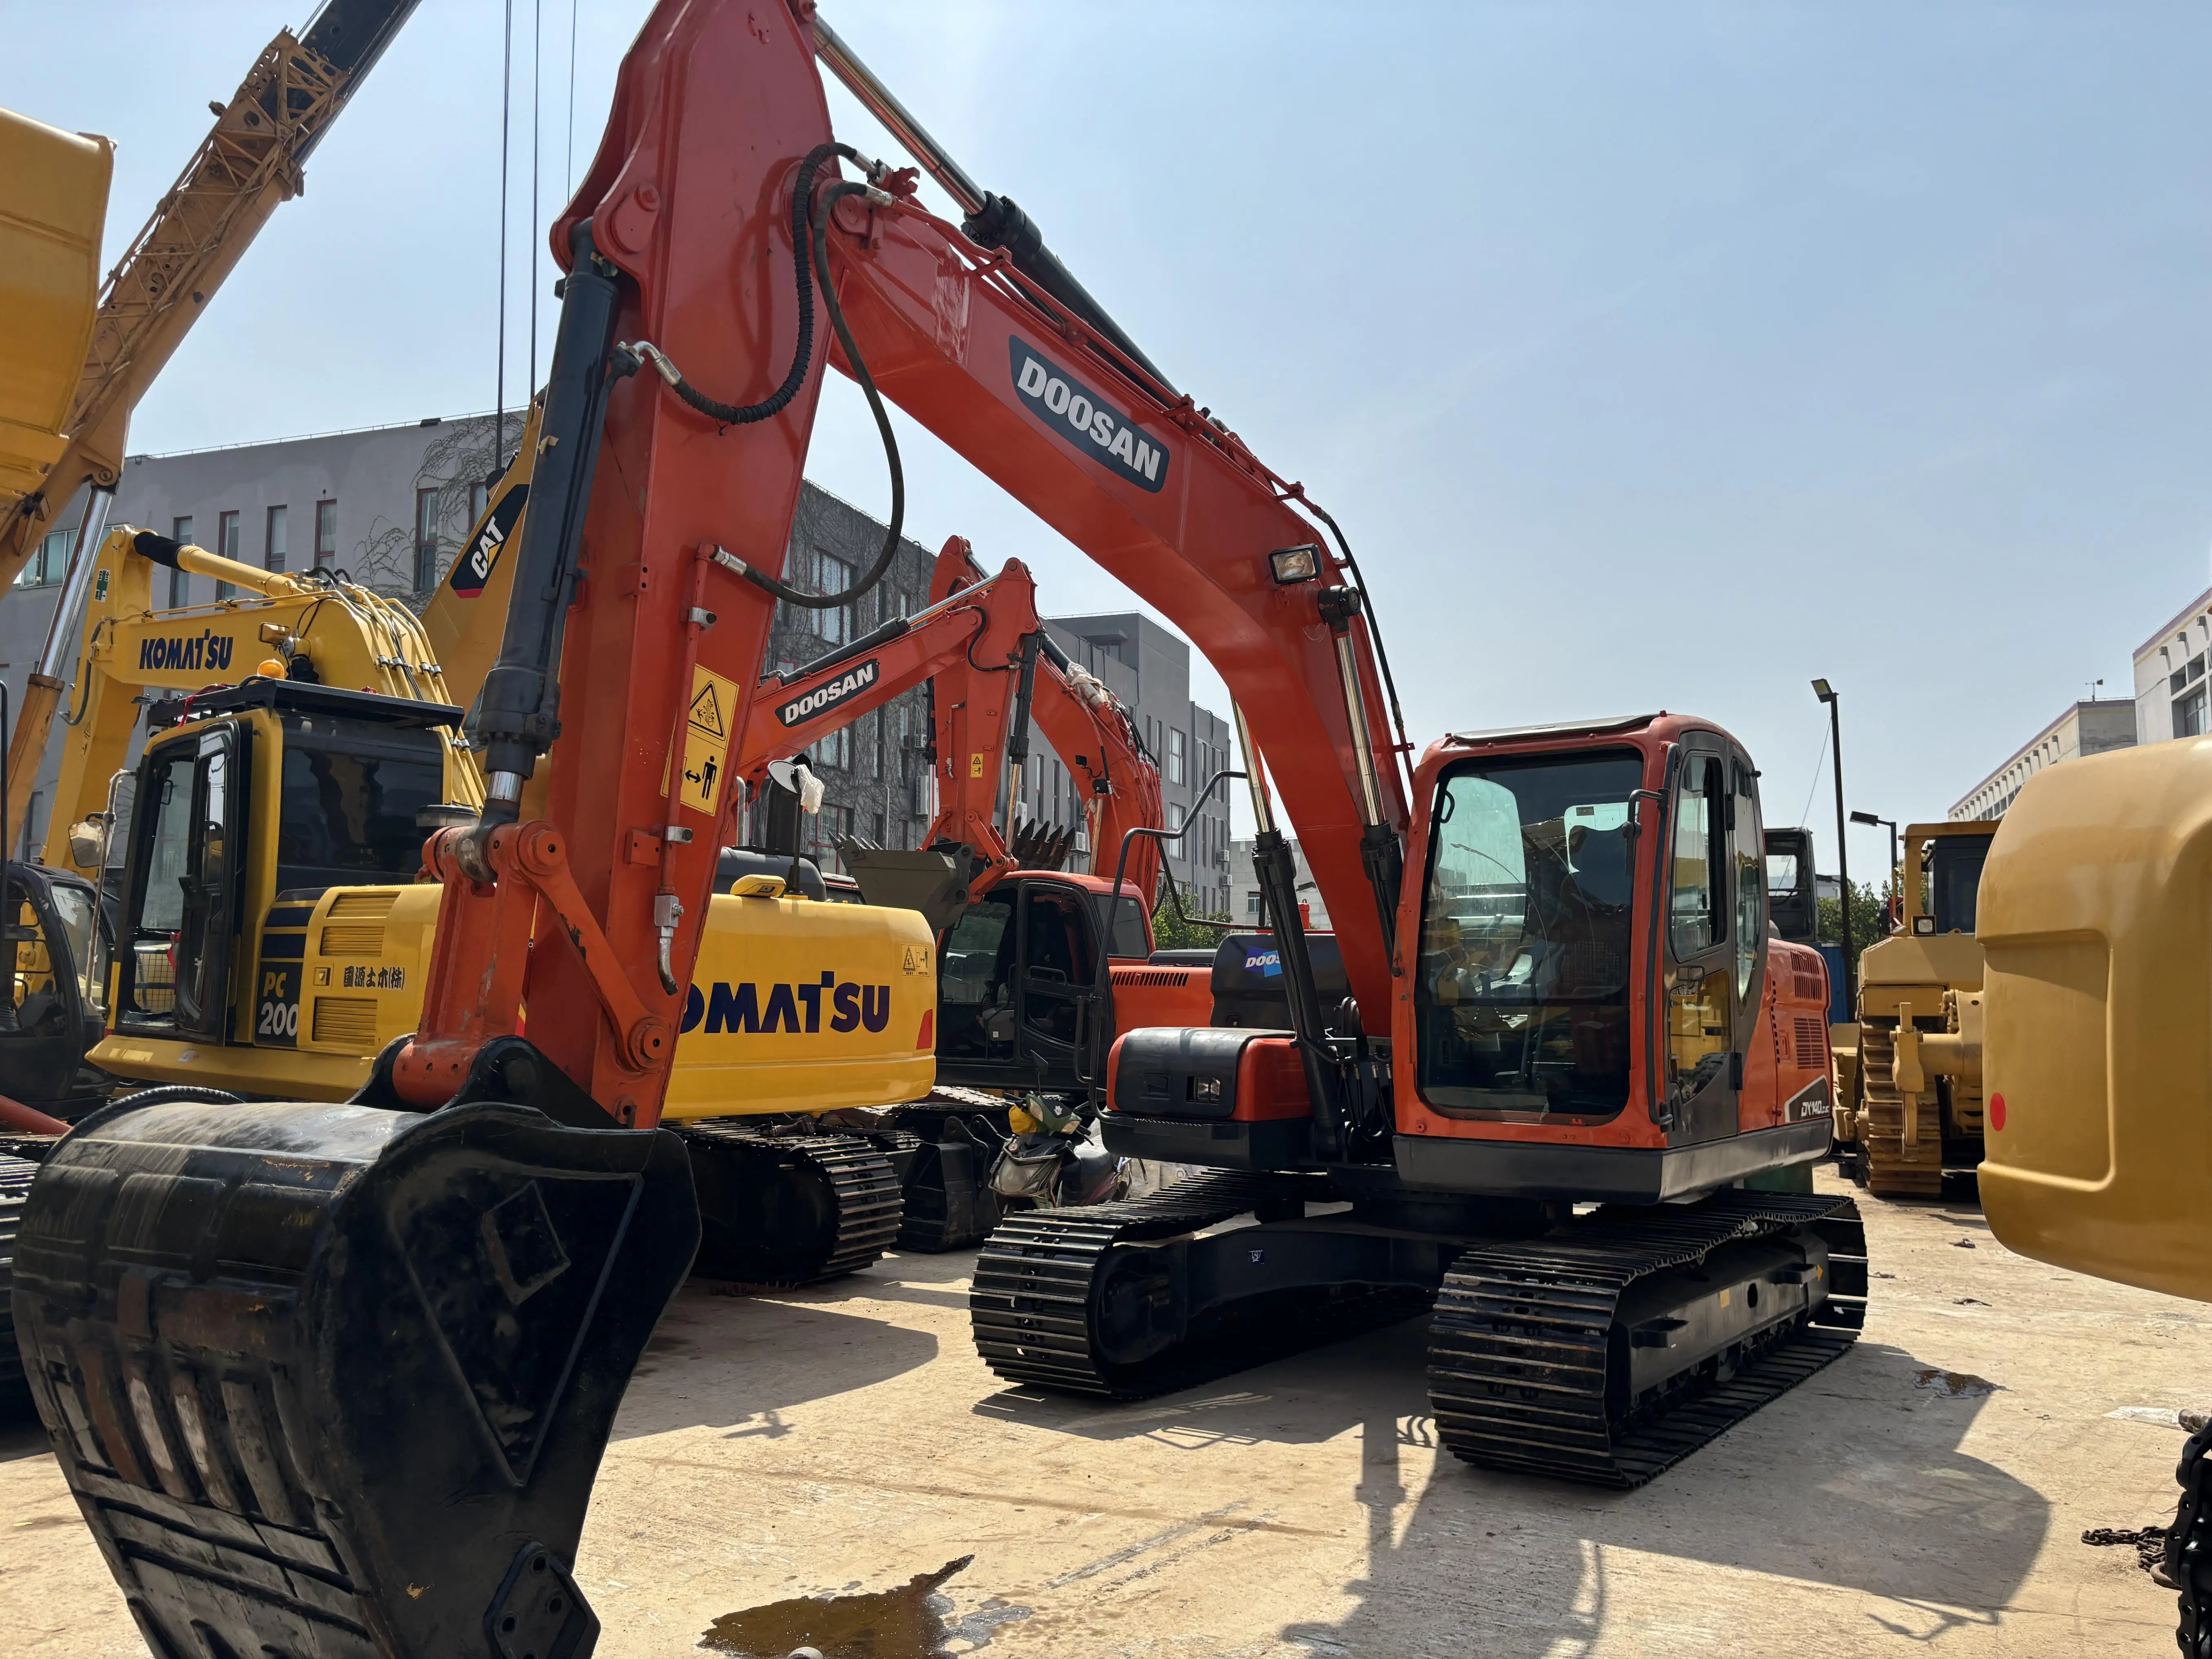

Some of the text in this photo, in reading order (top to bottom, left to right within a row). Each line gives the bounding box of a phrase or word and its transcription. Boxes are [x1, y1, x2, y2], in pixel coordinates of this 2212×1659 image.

[1018, 356, 1161, 482] DOOSAN
[471, 515, 504, 579] CAT
[139, 628, 234, 670] KOMATSU
[785, 663, 873, 724] DOOSAN
[263, 972, 287, 998] PC
[258, 1002, 299, 1036] 200
